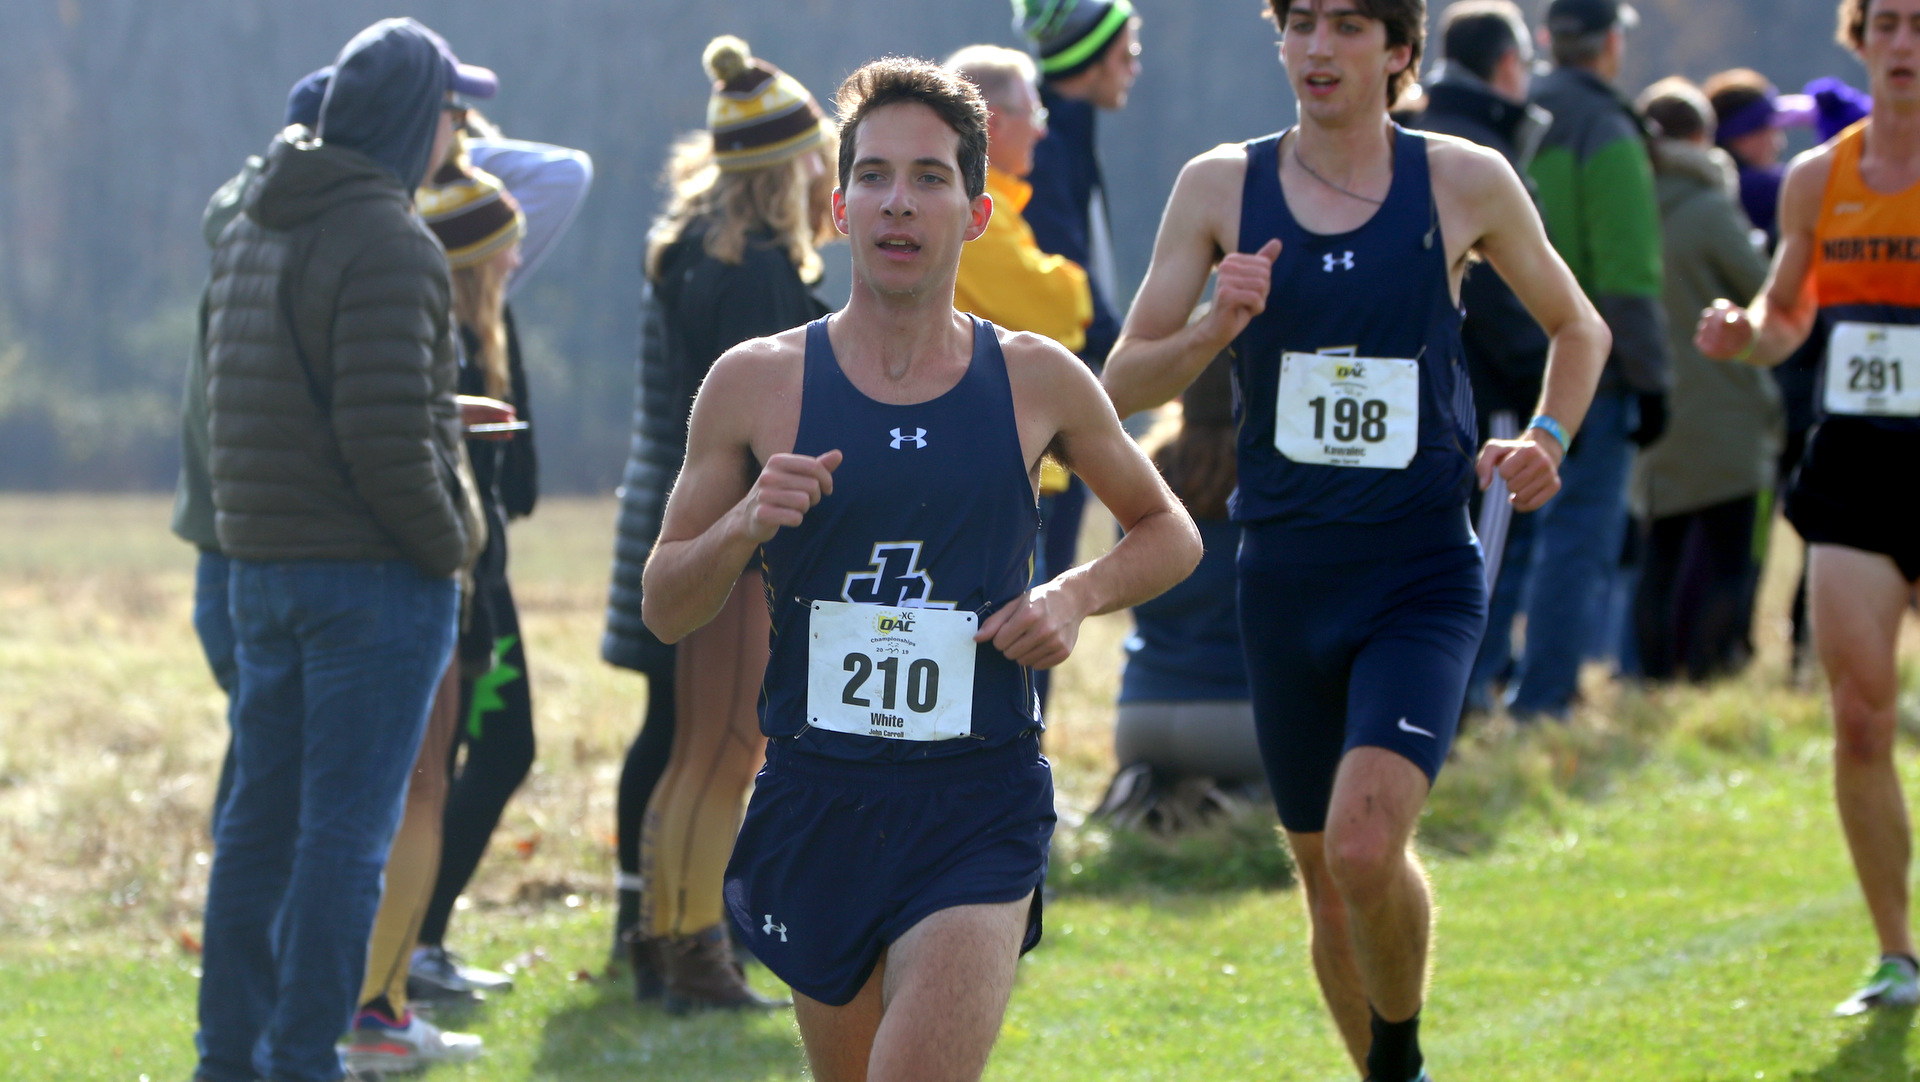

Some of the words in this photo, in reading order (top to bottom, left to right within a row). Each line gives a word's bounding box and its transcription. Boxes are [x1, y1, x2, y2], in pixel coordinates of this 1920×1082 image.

[1848, 356, 1903, 393] 291
[1308, 396, 1388, 443] 198
[880, 619, 916, 632] OAC
[870, 636, 916, 647] Championships
[842, 652, 940, 713] 210
[871, 712, 904, 728] White
[883, 730, 905, 738] Carroll
